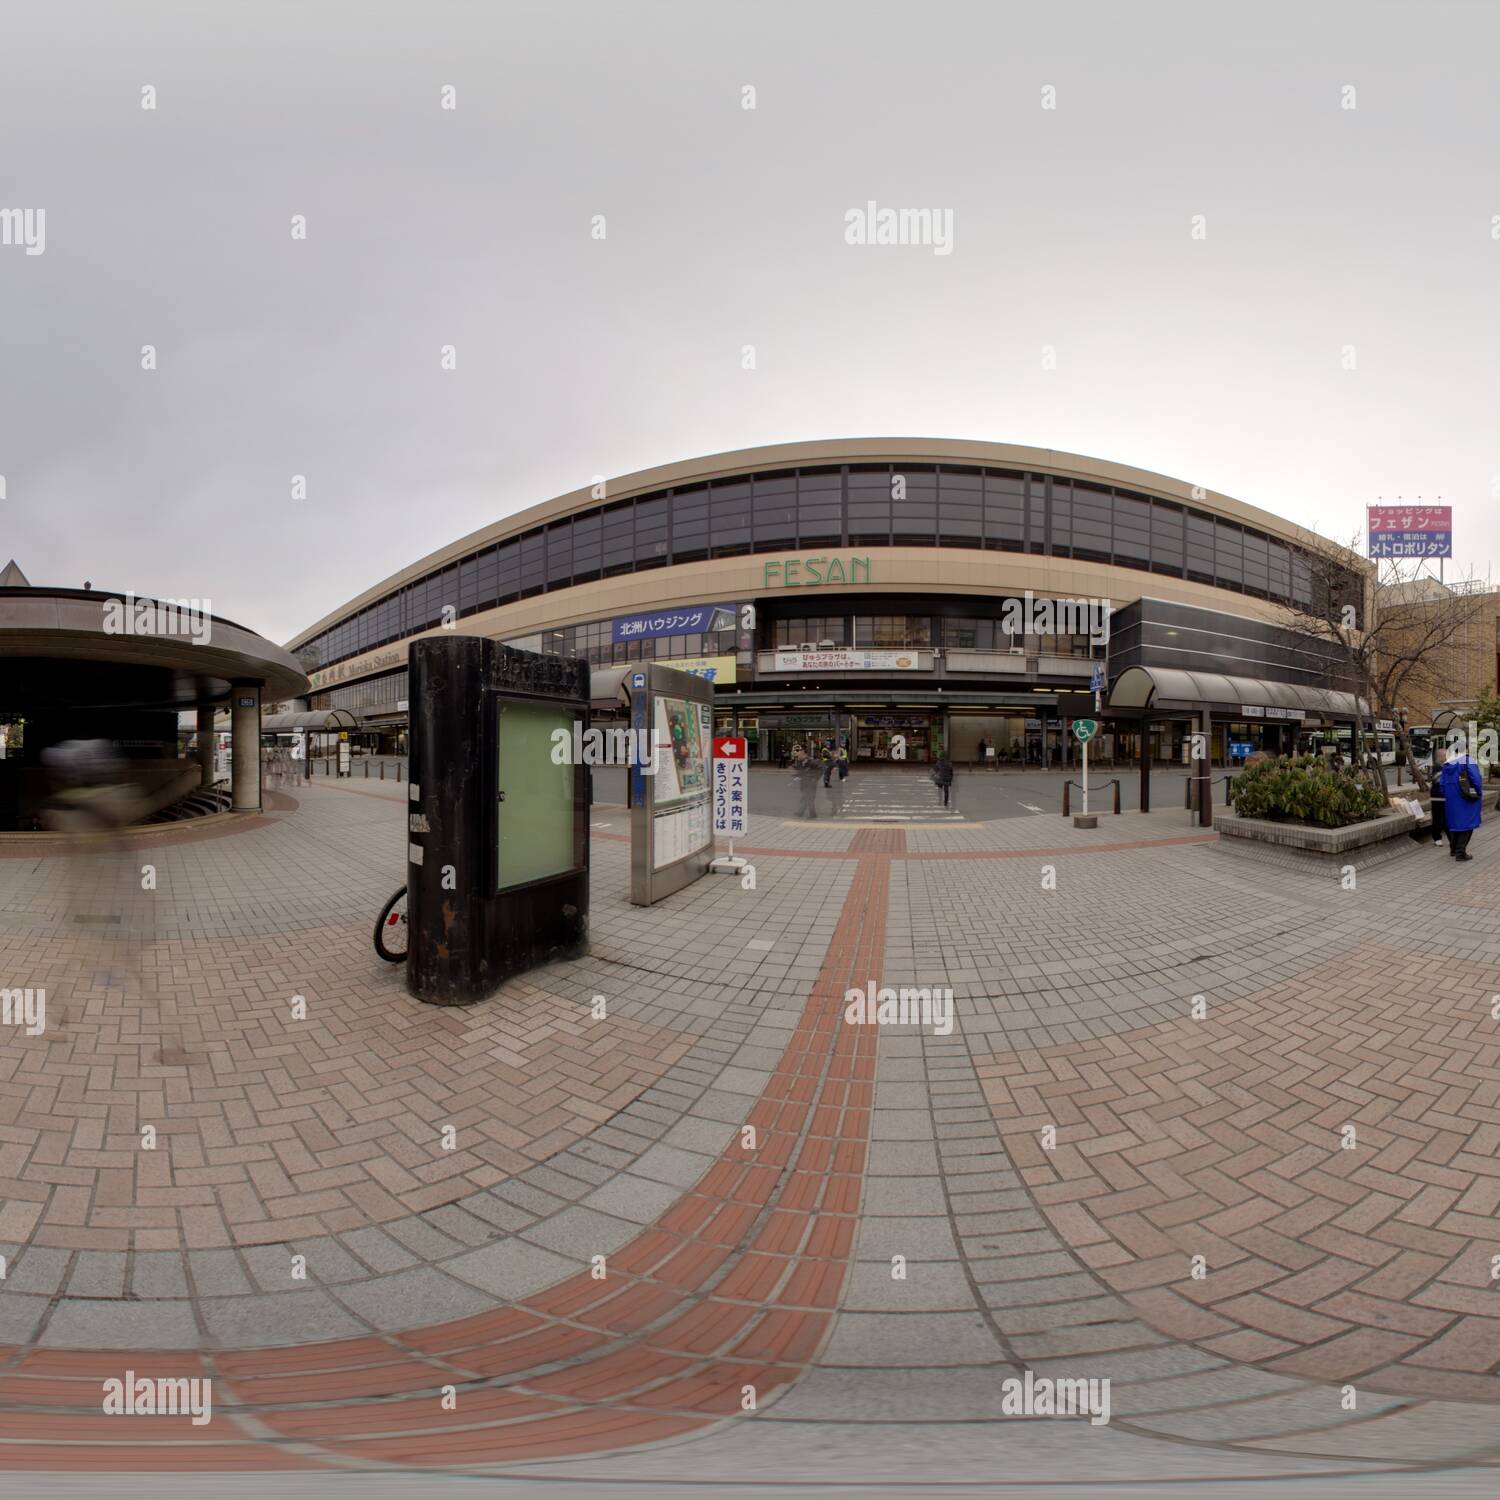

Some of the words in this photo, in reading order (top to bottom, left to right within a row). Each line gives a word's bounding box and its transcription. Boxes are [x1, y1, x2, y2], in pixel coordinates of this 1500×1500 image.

[1371, 517, 1429, 529] フェザン
[1370, 543, 1450, 556] メトロポリタン
[764, 557, 871, 589] FESAN
[620, 612, 702, 635] 北洲ハウジング
[716, 762, 727, 830] きっぷうりば
[731, 763, 743, 831] バス案内所
